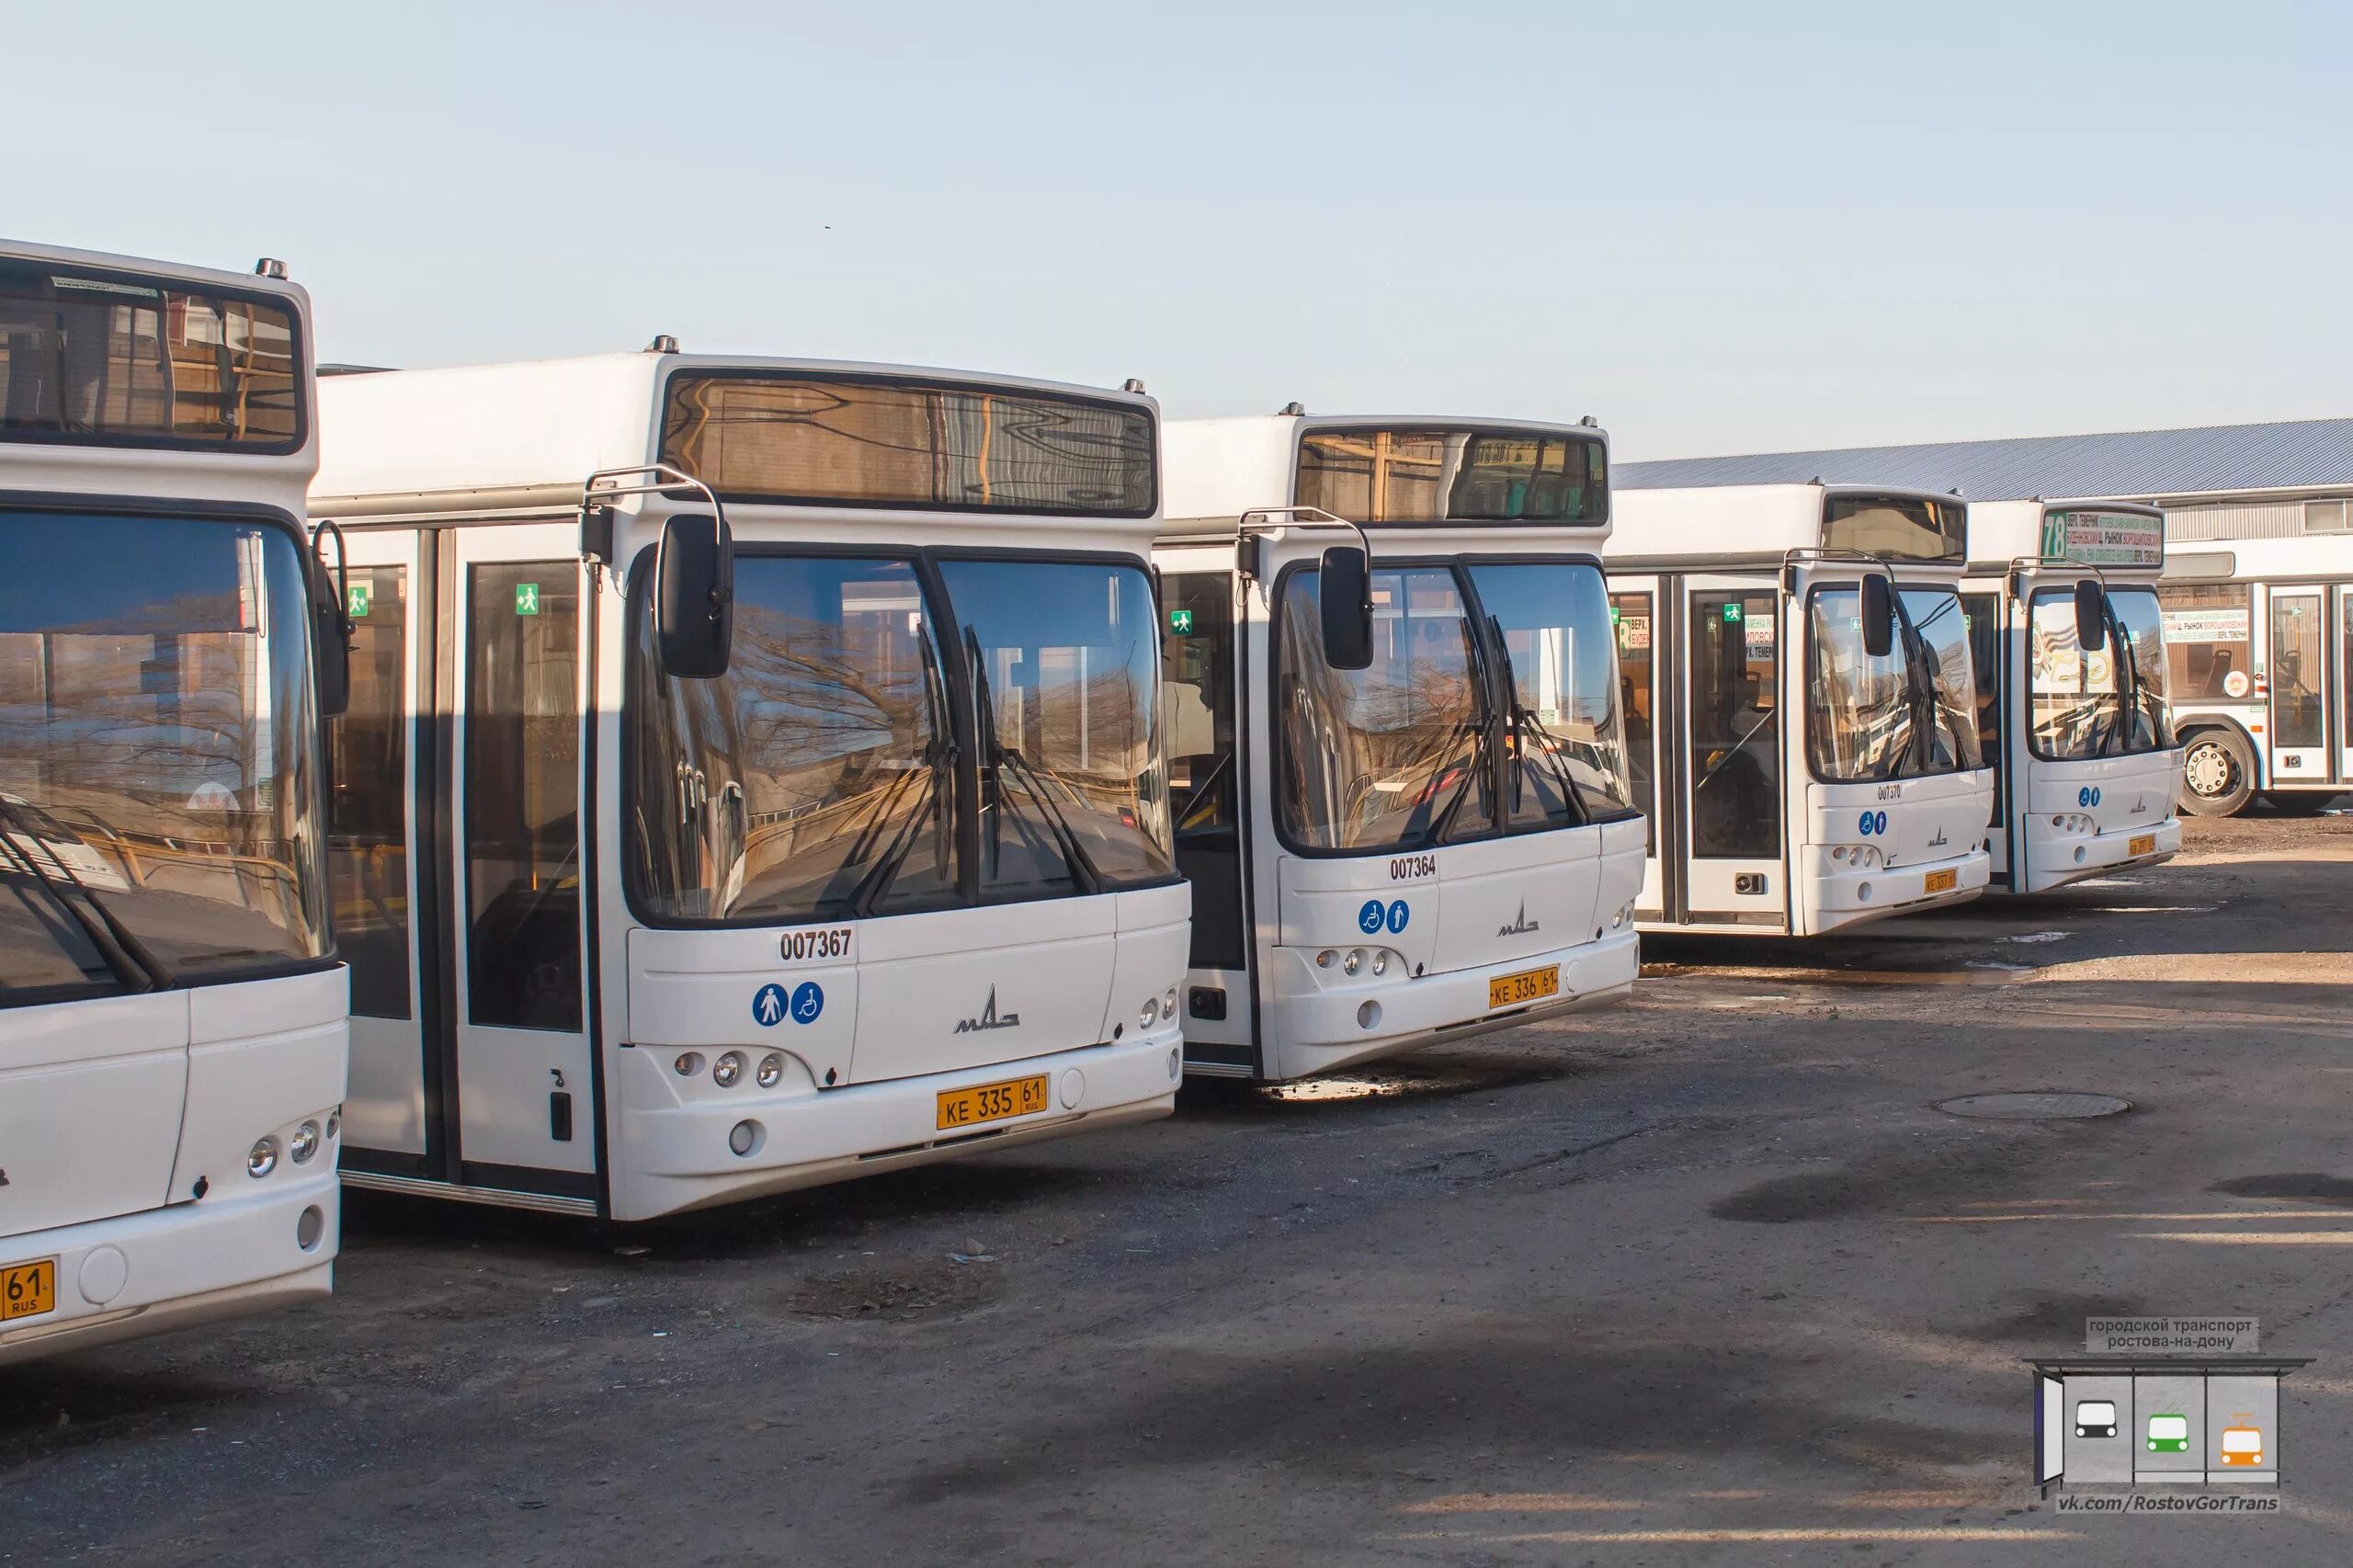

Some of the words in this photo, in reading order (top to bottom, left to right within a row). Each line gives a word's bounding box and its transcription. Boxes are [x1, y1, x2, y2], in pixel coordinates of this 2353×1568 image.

[2044, 516, 2065, 557] 78
[1631, 619, 1647, 631] ВЕРХ.
[1878, 784, 1901, 801] 007370
[1391, 855, 1436, 880] 007364
[780, 929, 852, 960] 007367
[1515, 975, 1536, 999] 336
[1543, 971, 1554, 987] 61
[978, 1087, 1012, 1118] 335
[1023, 1082, 1040, 1102] 61
[1025, 1102, 1039, 1110] RUS
[7, 1267, 40, 1301] 61
[12, 1299, 38, 1313] RUS
